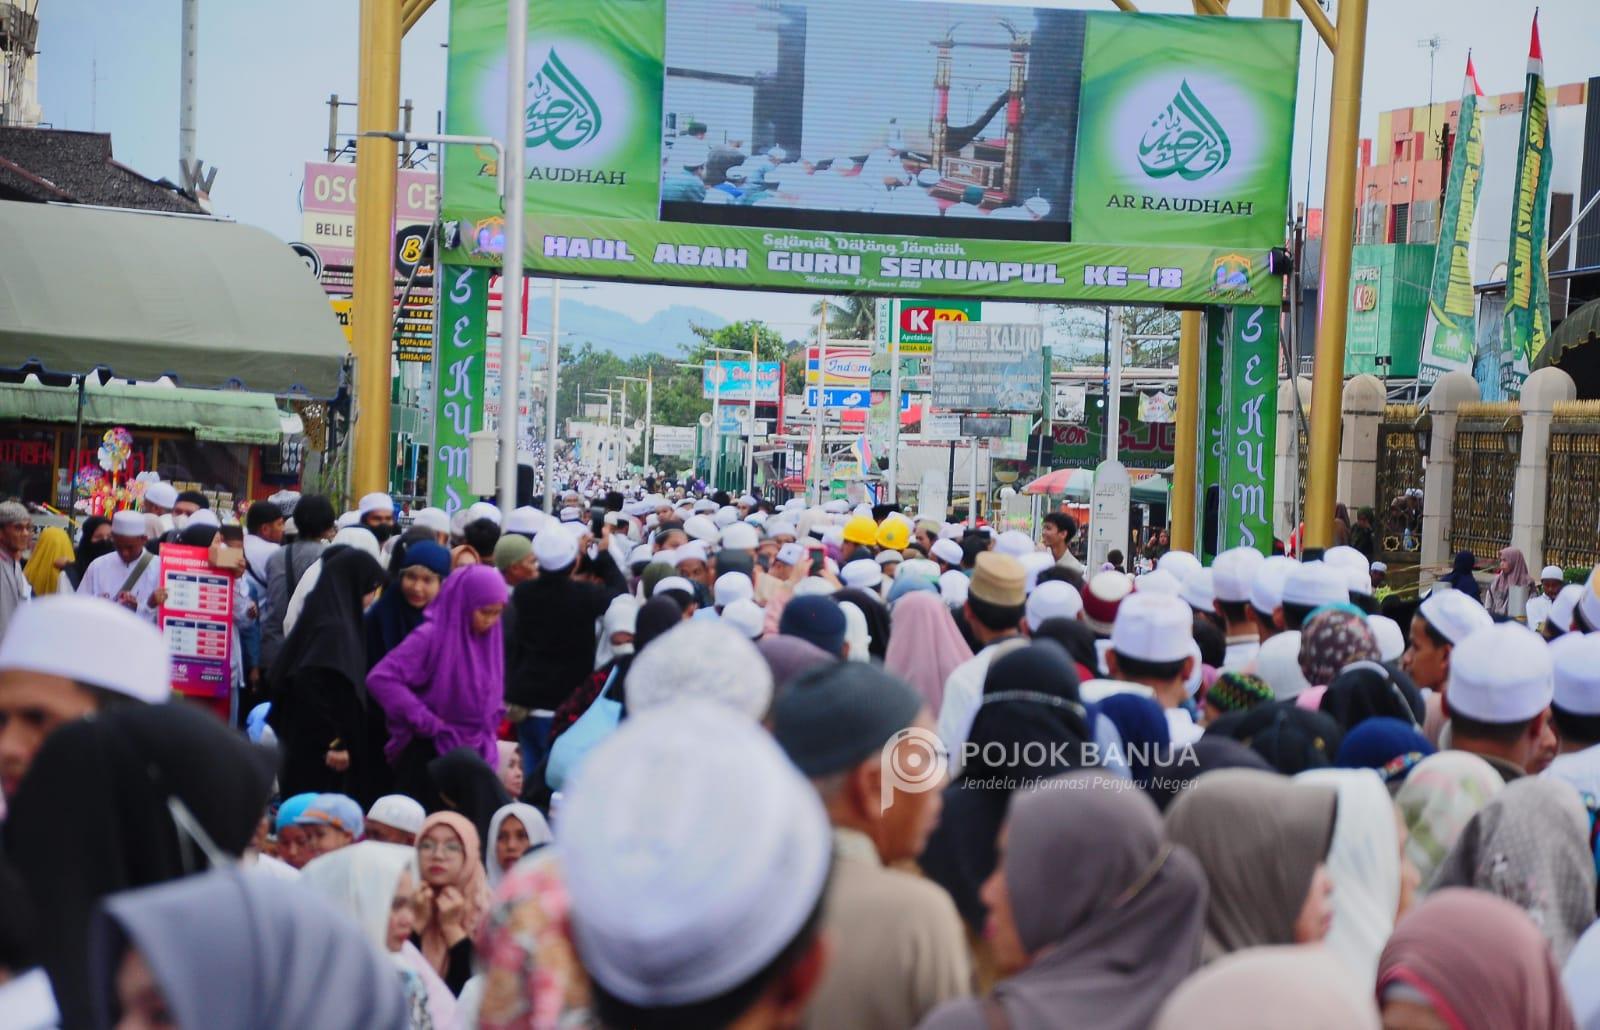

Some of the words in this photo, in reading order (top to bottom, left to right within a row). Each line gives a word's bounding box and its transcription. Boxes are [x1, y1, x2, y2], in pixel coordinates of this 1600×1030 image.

[1106, 194, 1136, 209] AR
[1141, 195, 1253, 216] RAUDHAH
[315, 222, 343, 237] BELI
[543, 235, 635, 262] HAUL
[653, 242, 748, 269] ABAH
[767, 250, 860, 276] GURU
[880, 256, 1065, 285] SEKUMPUL
[1083, 264, 1183, 289] KE-18
